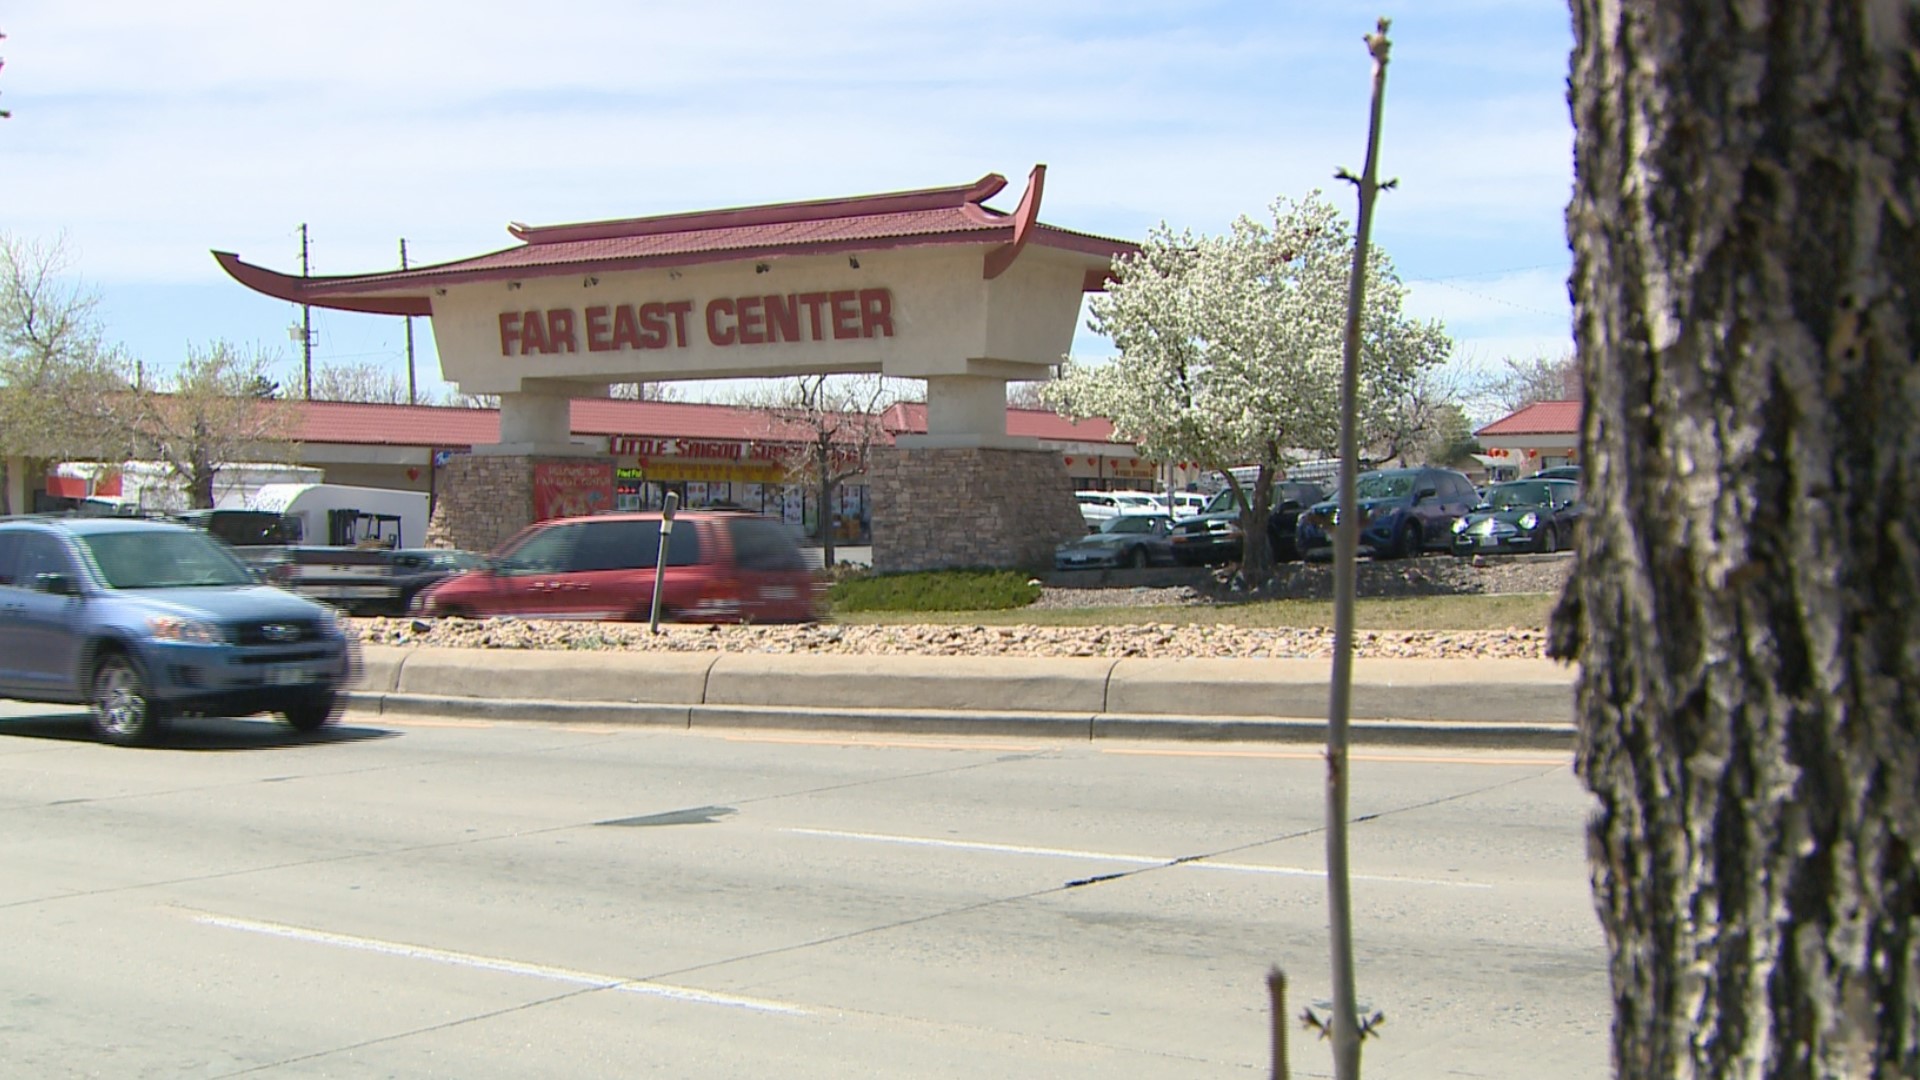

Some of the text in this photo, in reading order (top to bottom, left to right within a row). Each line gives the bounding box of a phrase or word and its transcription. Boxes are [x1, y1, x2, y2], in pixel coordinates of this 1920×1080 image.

[499, 287, 895, 357] FAR EAST CENTER
[610, 436, 668, 456] LITTLE
